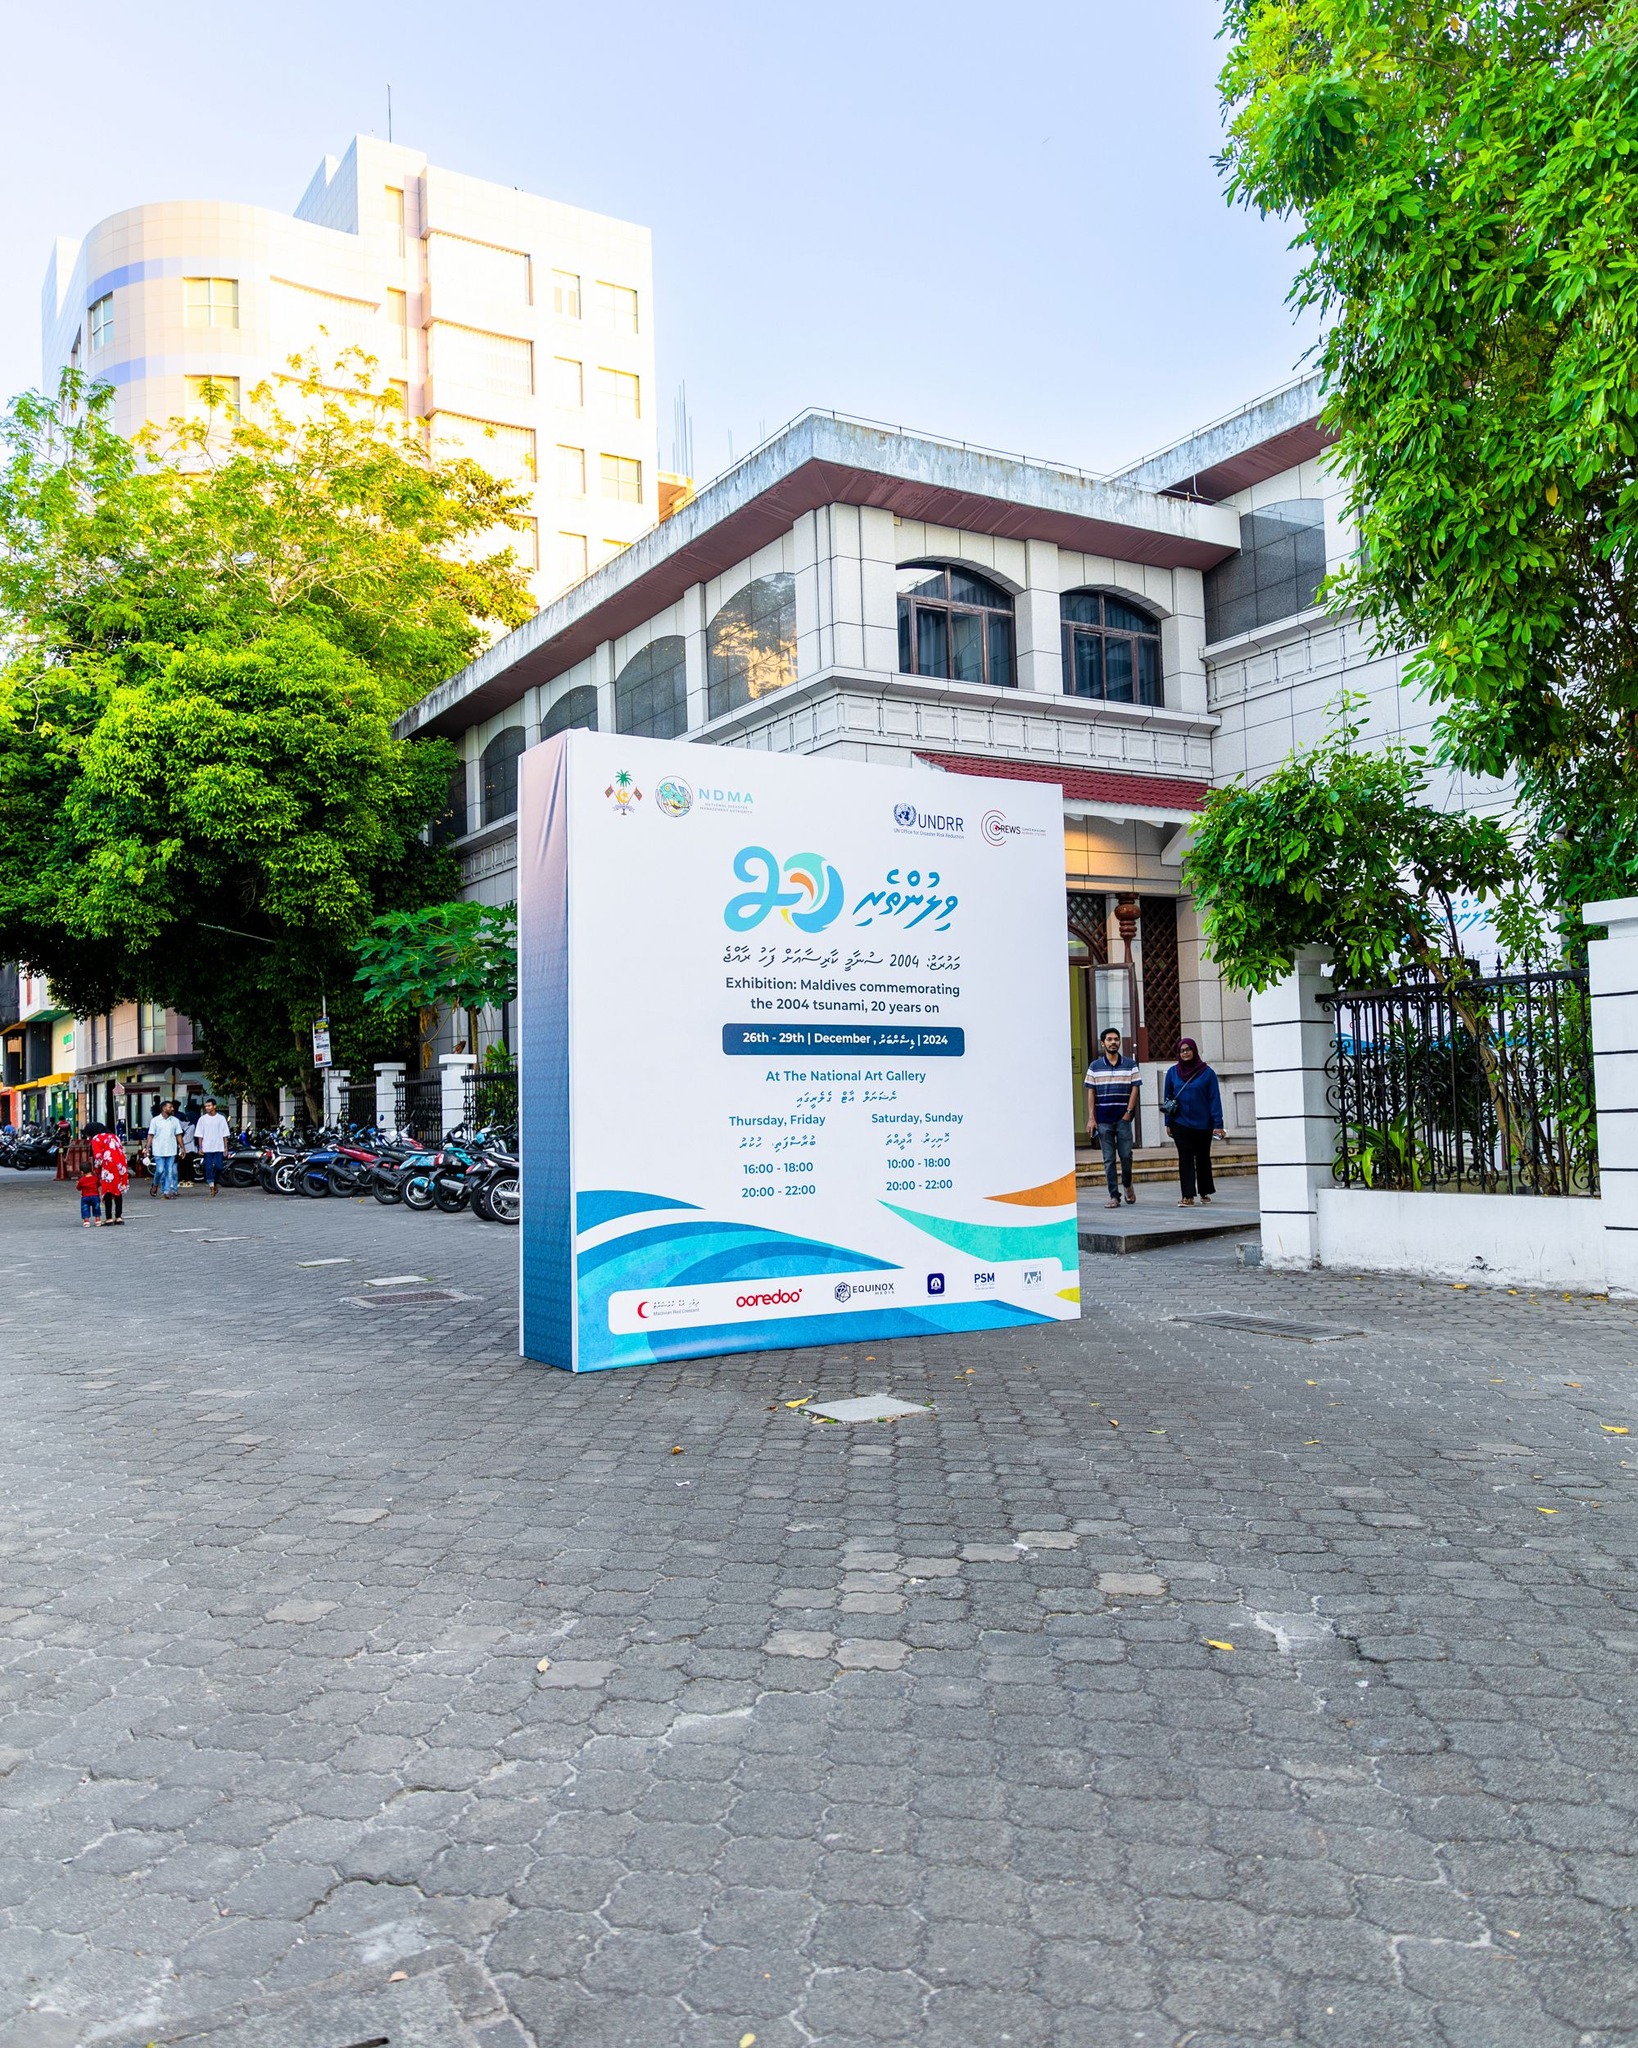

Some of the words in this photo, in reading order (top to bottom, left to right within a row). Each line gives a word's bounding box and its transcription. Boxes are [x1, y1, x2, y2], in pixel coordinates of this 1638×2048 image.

[698, 788, 754, 804] NDMA
[918, 813, 964, 833] UNDRR
[723, 845, 844, 933] 20
[889, 953, 919, 968] 2004
[725, 977, 798, 990] Exhibition:
[800, 978, 857, 992] Maldives
[859, 983, 960, 997] commemorating
[750, 998, 773, 1009] the
[776, 998, 810, 1010] 2004
[812, 999, 868, 1014] tsunami,
[871, 1000, 886, 1012] 20
[889, 1003, 922, 1015] years
[924, 1004, 940, 1013] on
[742, 1032, 769, 1043] 26th
[779, 1032, 805, 1043] 29th
[814, 1033, 871, 1044] December
[923, 1034, 948, 1045] 2024
[766, 1071, 780, 1082] At
[784, 1071, 809, 1082] The
[811, 1070, 861, 1081] National
[865, 1070, 883, 1081] Art
[886, 1070, 927, 1083] Gallery
[729, 1115, 787, 1127] Thursday,
[790, 1114, 826, 1127] Friday
[871, 1112, 922, 1124] Saturday,
[925, 1112, 964, 1124] Sunday
[743, 1163, 774, 1175] 16:00
[784, 1161, 814, 1173] 18:00
[887, 1158, 915, 1169] 10:00
[924, 1157, 951, 1168] 18:00
[741, 1186, 775, 1198] 20:00
[785, 1184, 816, 1196] 22:00
[885, 1180, 916, 1191] 20:00
[925, 1179, 953, 1190] 22:00
[974, 1271, 995, 1284] PSM
[852, 1282, 895, 1294] EQUINOX
[736, 1288, 803, 1309] ooredoo
